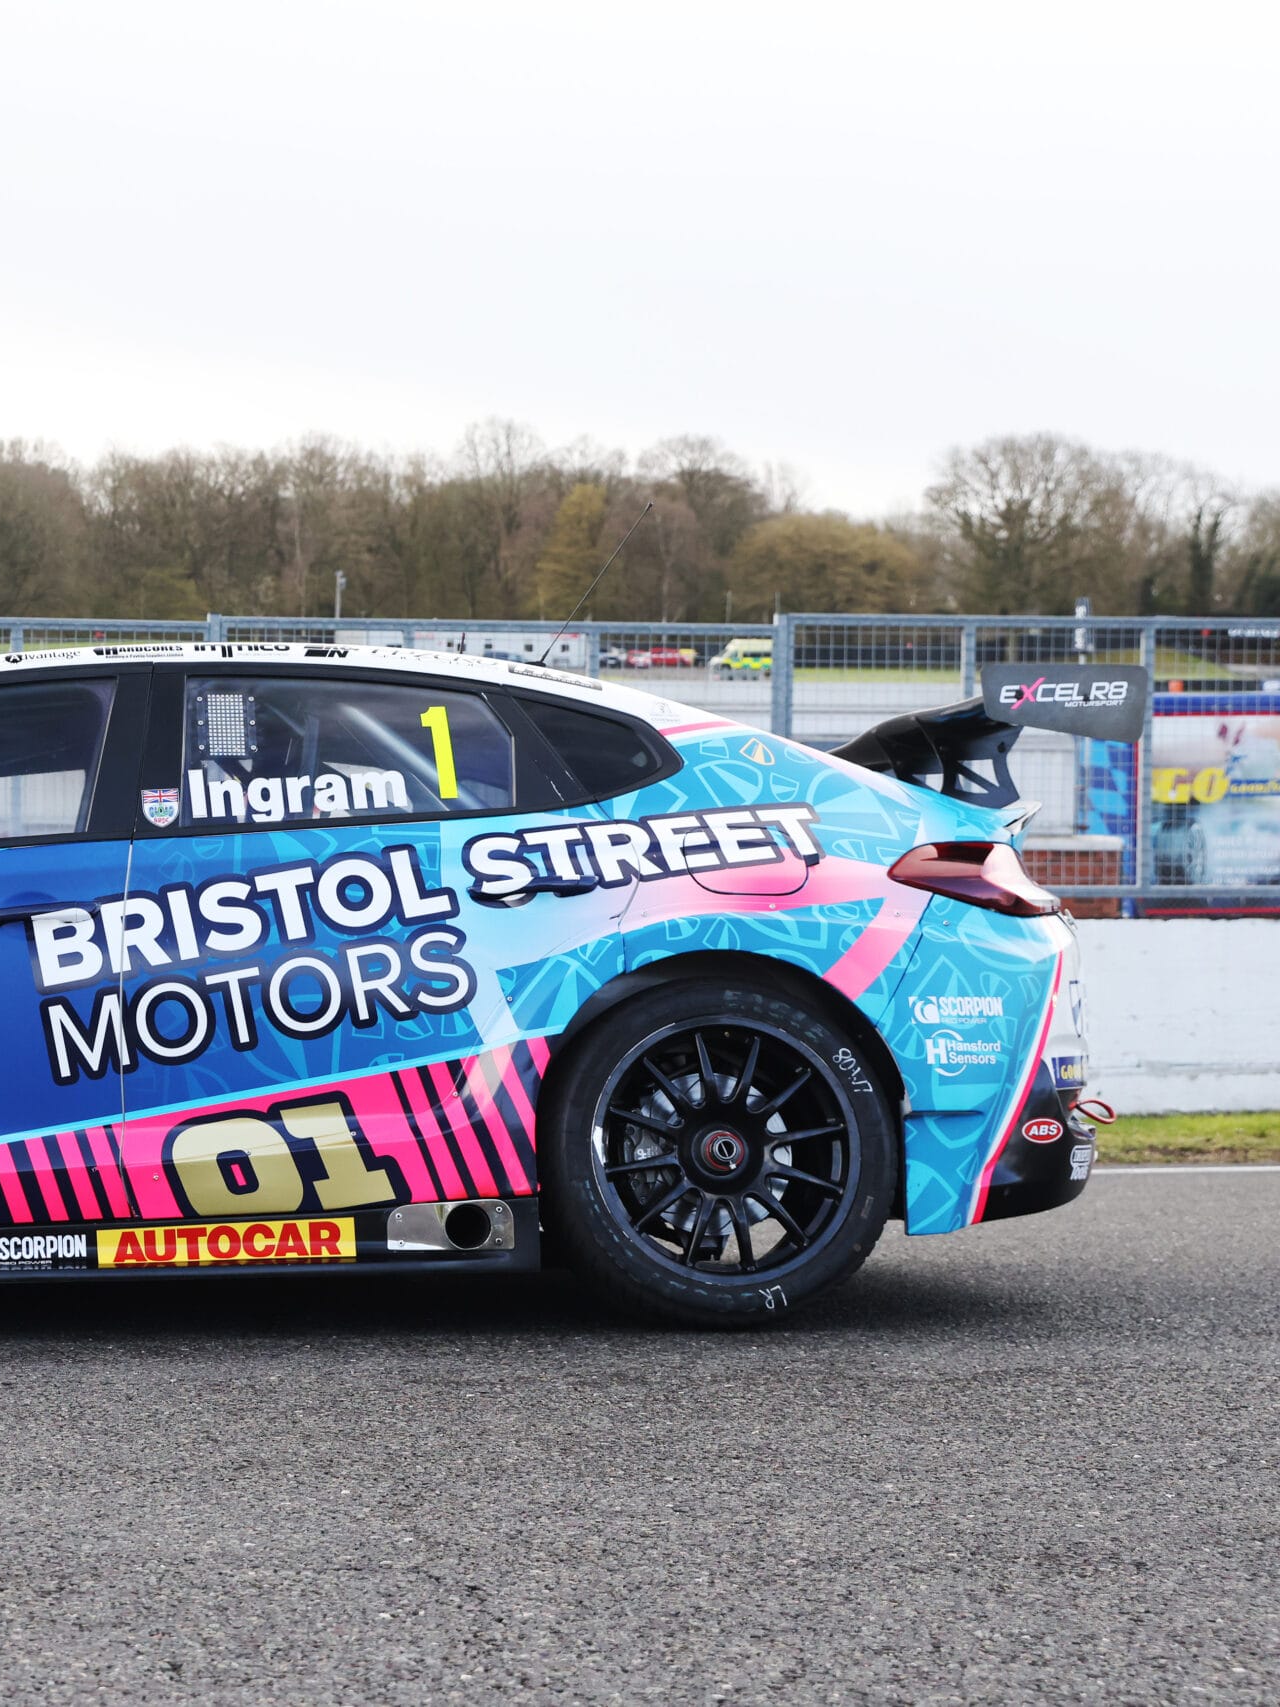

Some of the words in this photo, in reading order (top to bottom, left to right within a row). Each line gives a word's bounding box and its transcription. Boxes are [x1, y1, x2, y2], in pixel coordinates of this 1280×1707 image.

[420, 706, 458, 799] 1
[188, 769, 408, 823] Ingram
[32, 847, 455, 986] BRISTOL
[470, 810, 814, 895] STREET
[50, 939, 469, 1078] MOTORS
[938, 996, 1004, 1017] SCORPION
[947, 1040, 1001, 1052] Hansford
[948, 1052, 997, 1065] Sensors
[1028, 1124, 1058, 1137] ABS
[171, 1102, 396, 1216] 01
[113, 1223, 342, 1263] AUTOCAR
[758, 1285, 787, 1309] LR
